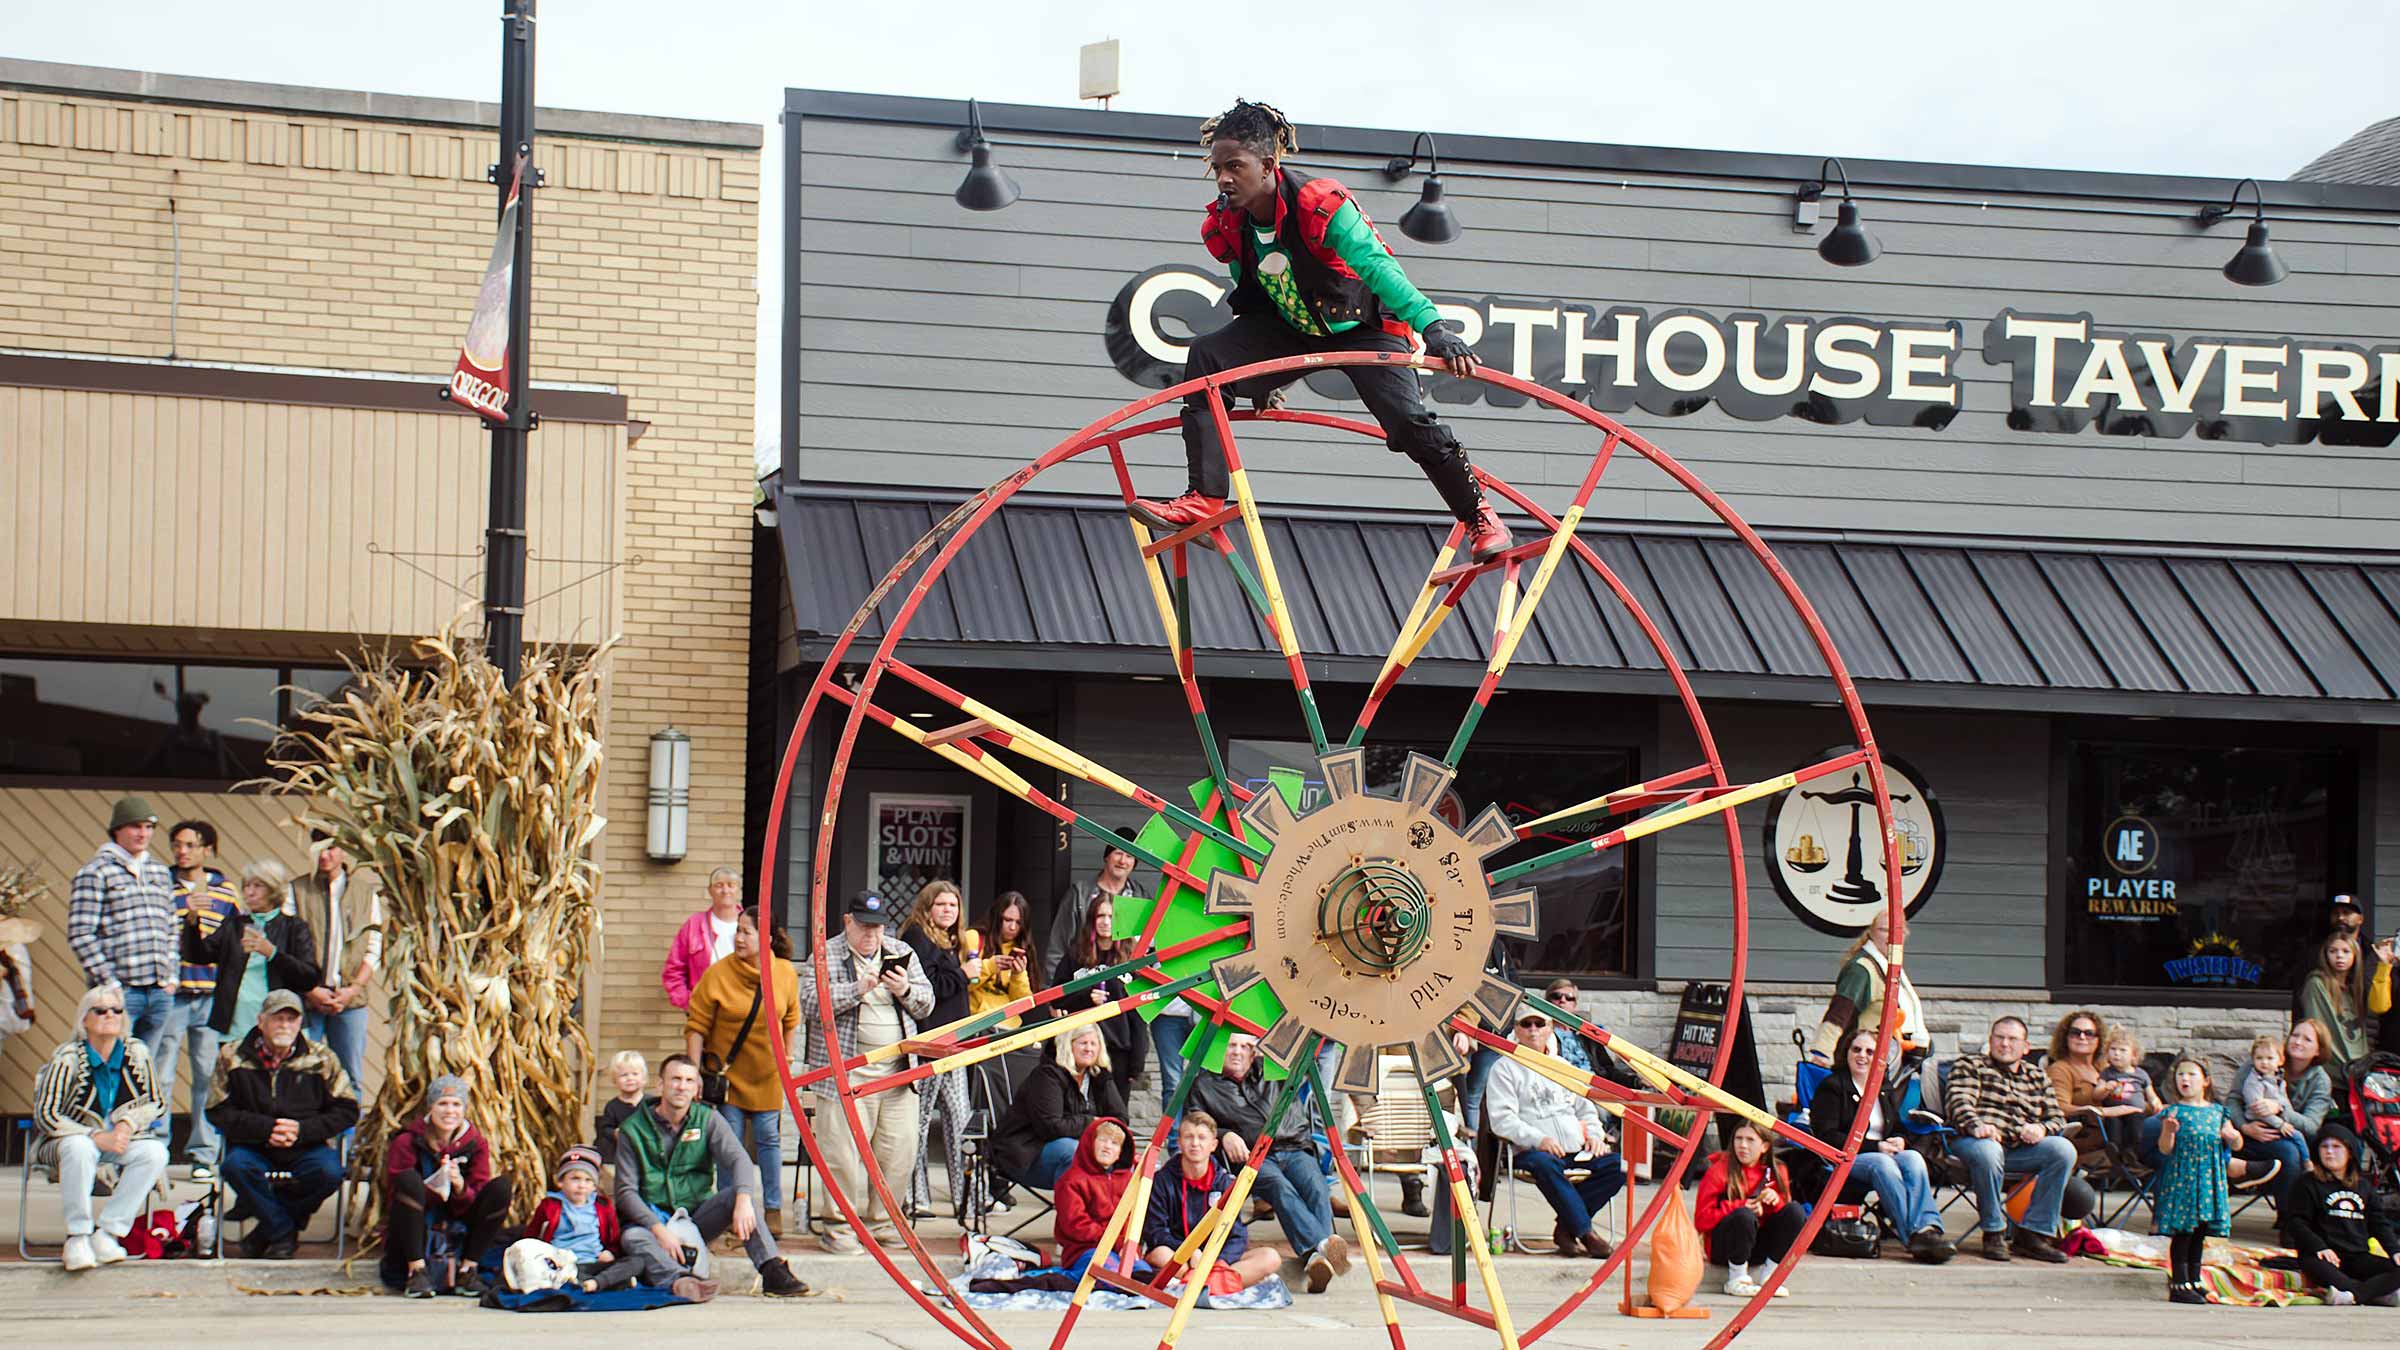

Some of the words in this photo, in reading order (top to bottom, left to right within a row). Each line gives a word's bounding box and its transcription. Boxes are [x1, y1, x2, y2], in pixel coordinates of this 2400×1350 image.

[1129, 271, 1957, 406] CRTHOUSE
[2005, 314, 2400, 424] TAVER
[451, 369, 509, 413] OREGON
[894, 807, 945, 824] PLAY
[882, 825, 957, 848] SLOTS
[2116, 829, 2145, 862] AE
[886, 847, 902, 865] &
[904, 847, 952, 866] WIN!
[2087, 877, 2177, 900] PLAYER
[2087, 899, 2178, 915] REWARDS
[2163, 955, 2229, 983] TWISTED
[1682, 1024, 1699, 1041] HIT
[1699, 1026, 1716, 1044] THE
